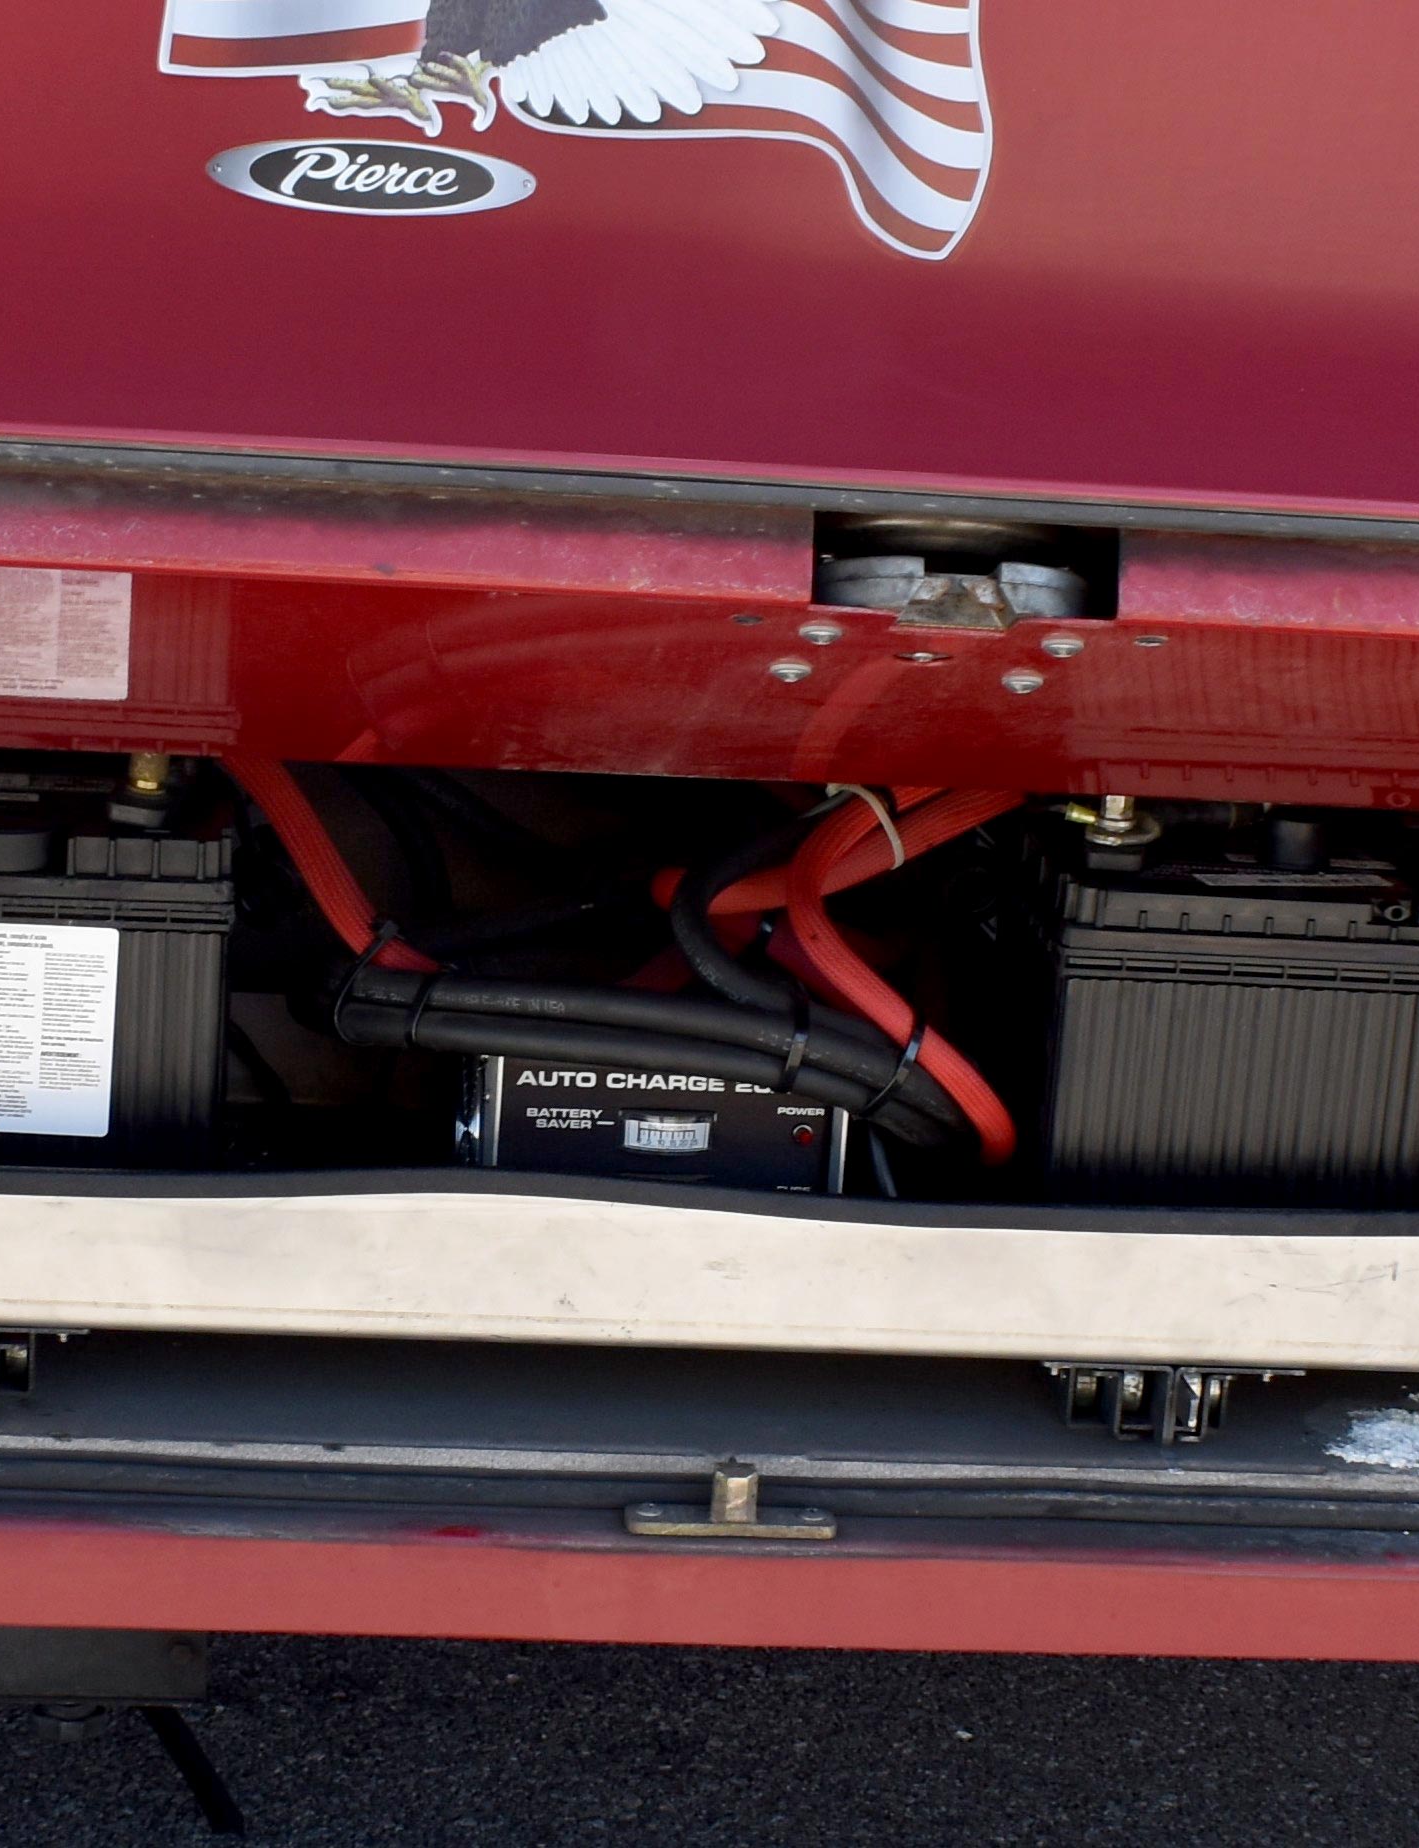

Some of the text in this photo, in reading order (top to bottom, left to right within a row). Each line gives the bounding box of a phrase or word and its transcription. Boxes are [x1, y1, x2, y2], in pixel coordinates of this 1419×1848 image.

[280, 146, 459, 196] Pierce
[516, 1070, 597, 1088] AUTO
[606, 1073, 725, 1093] CHARGE
[526, 1108, 603, 1119] BATTERY
[776, 1106, 826, 1117] POWER
[536, 1118, 592, 1130] SAVER
